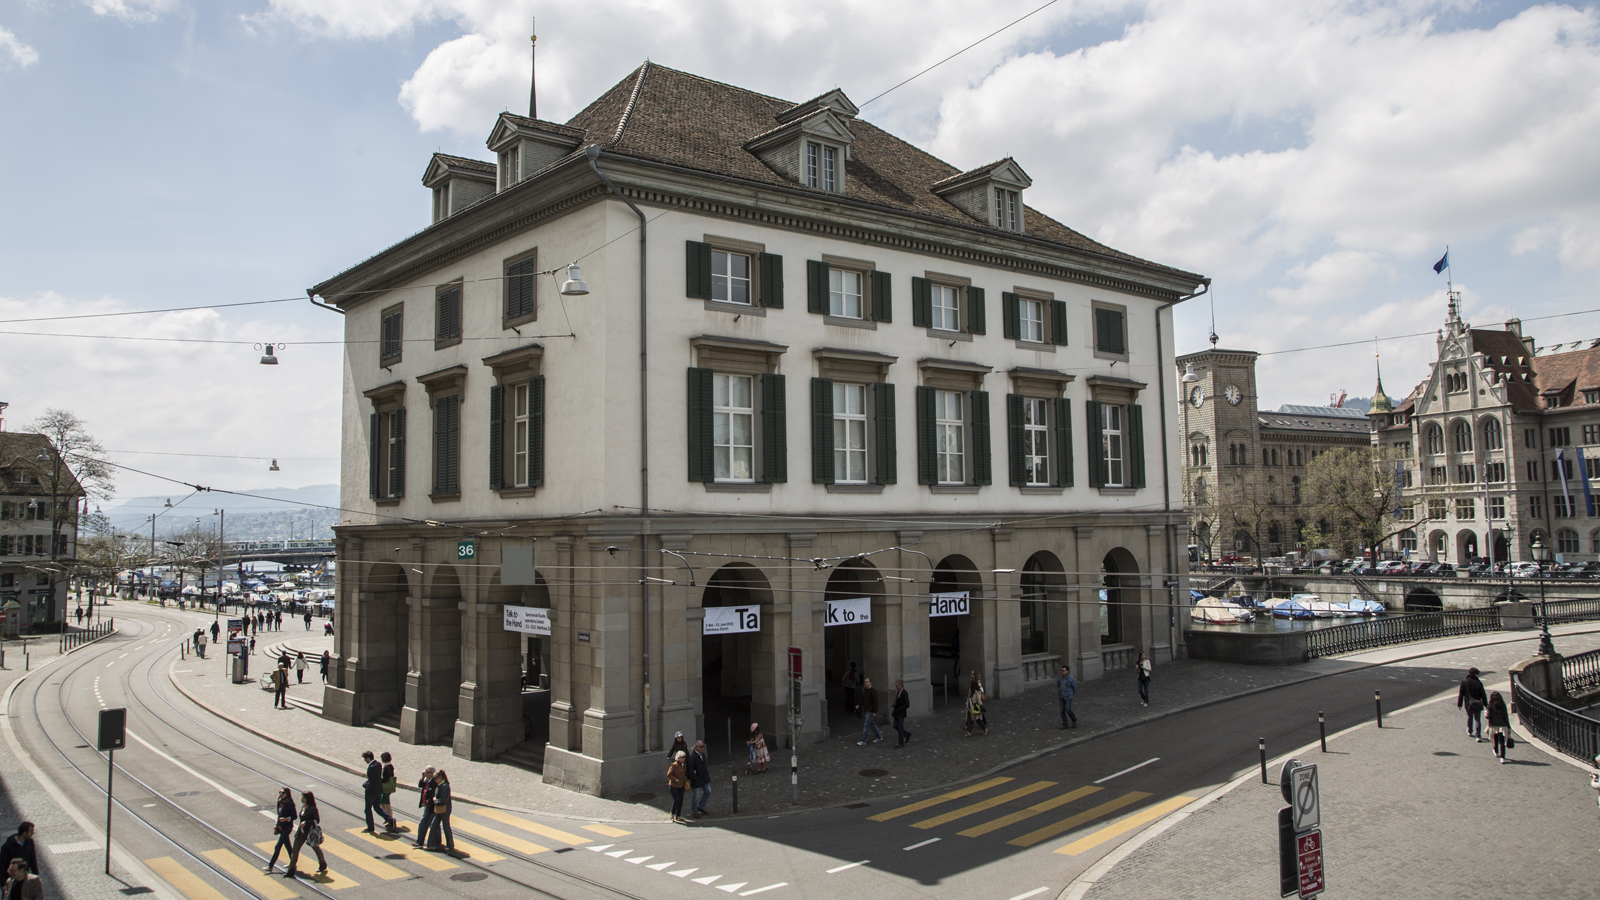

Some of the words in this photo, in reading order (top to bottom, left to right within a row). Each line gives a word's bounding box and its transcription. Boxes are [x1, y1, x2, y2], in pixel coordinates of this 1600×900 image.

[458, 545, 474, 556] 36
[930, 593, 967, 614] Hand
[735, 608, 758, 629] Ta
[843, 608, 855, 621] to
[1299, 772, 1311, 781] ZONE
